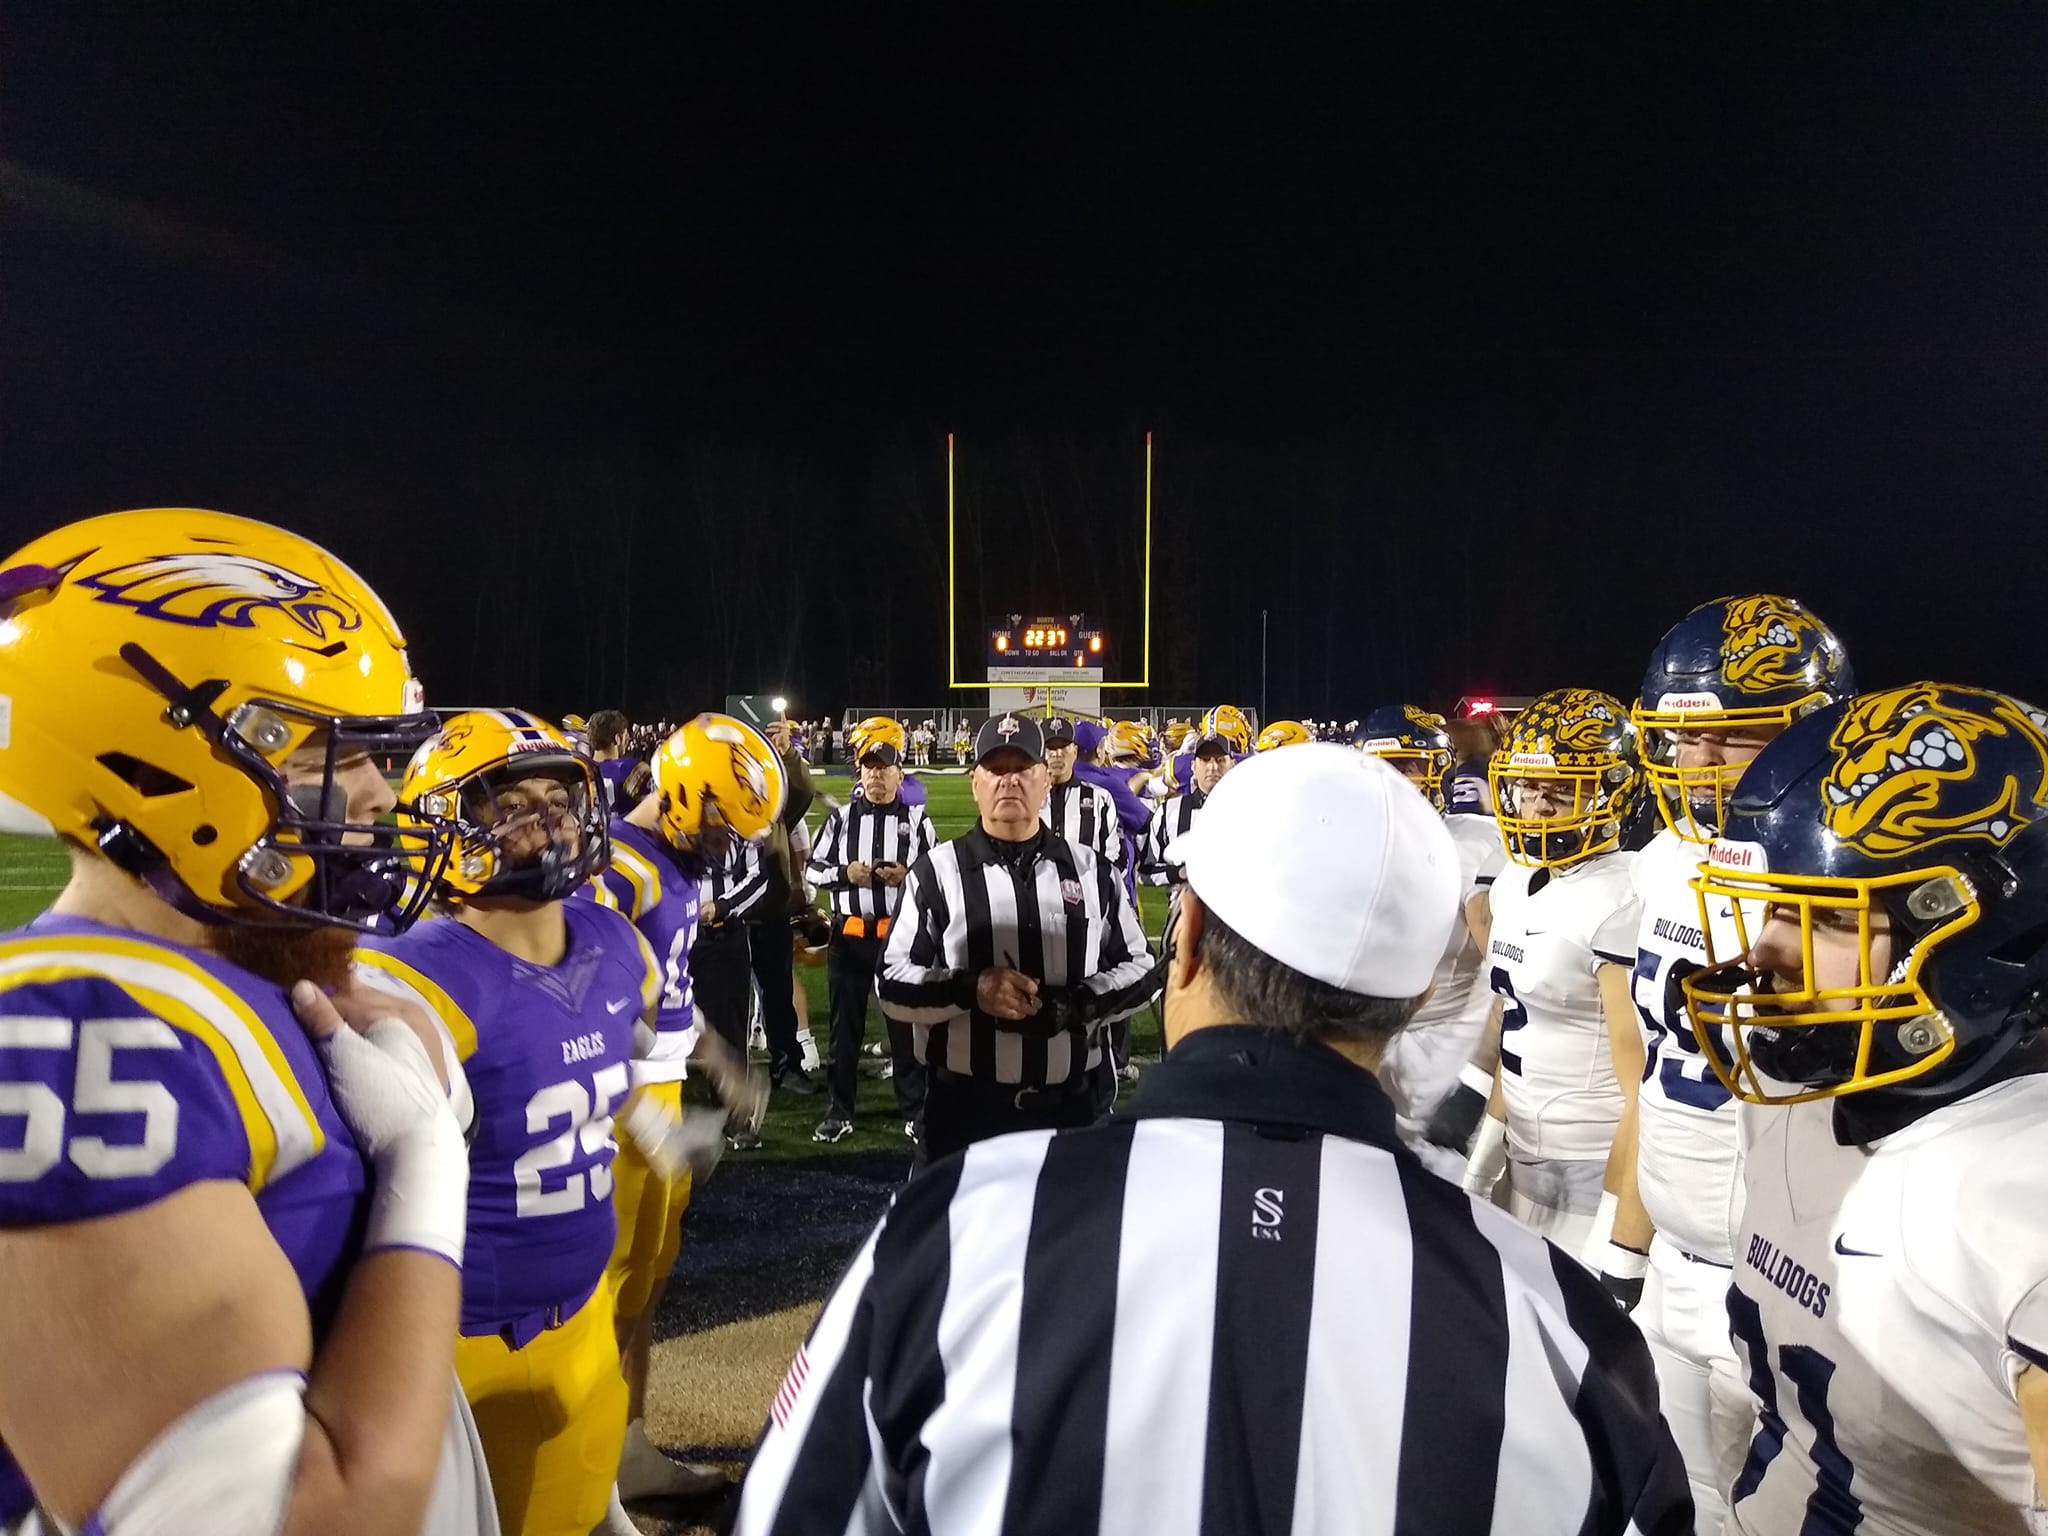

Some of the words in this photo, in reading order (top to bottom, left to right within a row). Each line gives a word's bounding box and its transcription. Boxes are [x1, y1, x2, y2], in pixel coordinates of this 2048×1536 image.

[992, 631, 1011, 639] HOME
[1078, 631, 1100, 640] GUEST
[1711, 844, 1752, 866] Riddell
[1492, 940, 1524, 964] BULLDOGS
[1490, 965, 1529, 1078] 2
[561, 1030, 606, 1065] EAGLES
[0, 1014, 183, 1183] 55
[513, 1060, 629, 1218] 25
[1745, 1233, 1831, 1319] BULLDOGS
